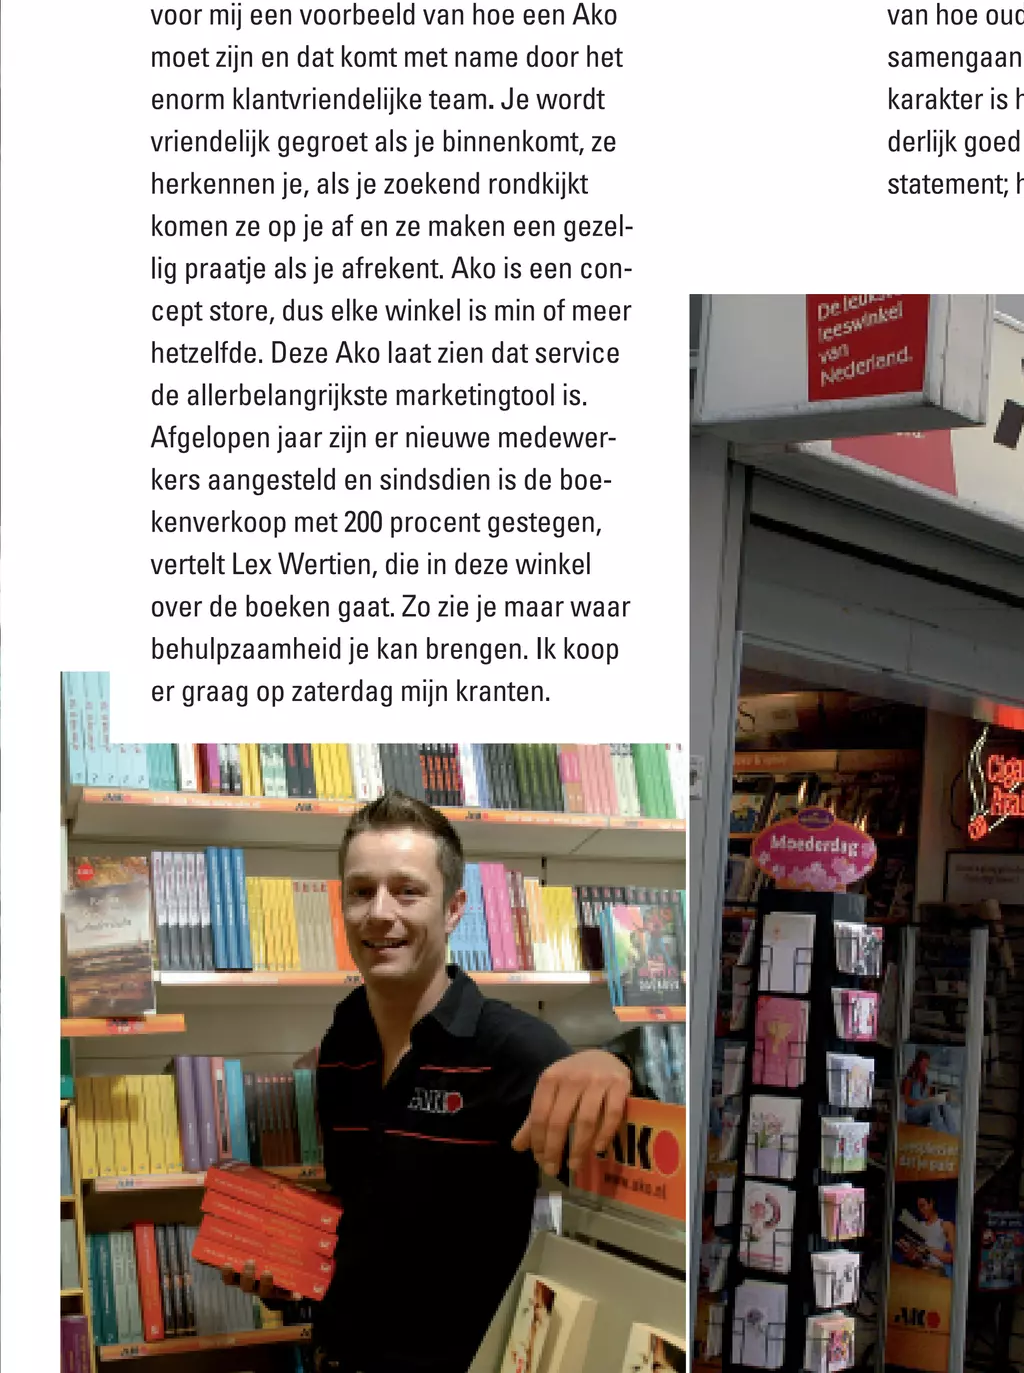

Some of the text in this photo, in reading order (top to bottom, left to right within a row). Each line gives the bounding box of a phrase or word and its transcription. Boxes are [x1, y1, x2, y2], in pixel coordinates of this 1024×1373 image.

[818, 302, 841, 321] De
[818, 300, 903, 344] leeswinkel
[818, 343, 849, 364] van
[151, 509, 602, 539] kenverkoop met 200 procent gestegen,
[151, 678, 550, 708] er graag op zaterdag mijn kranten.
[770, 833, 858, 857] Moederdag
